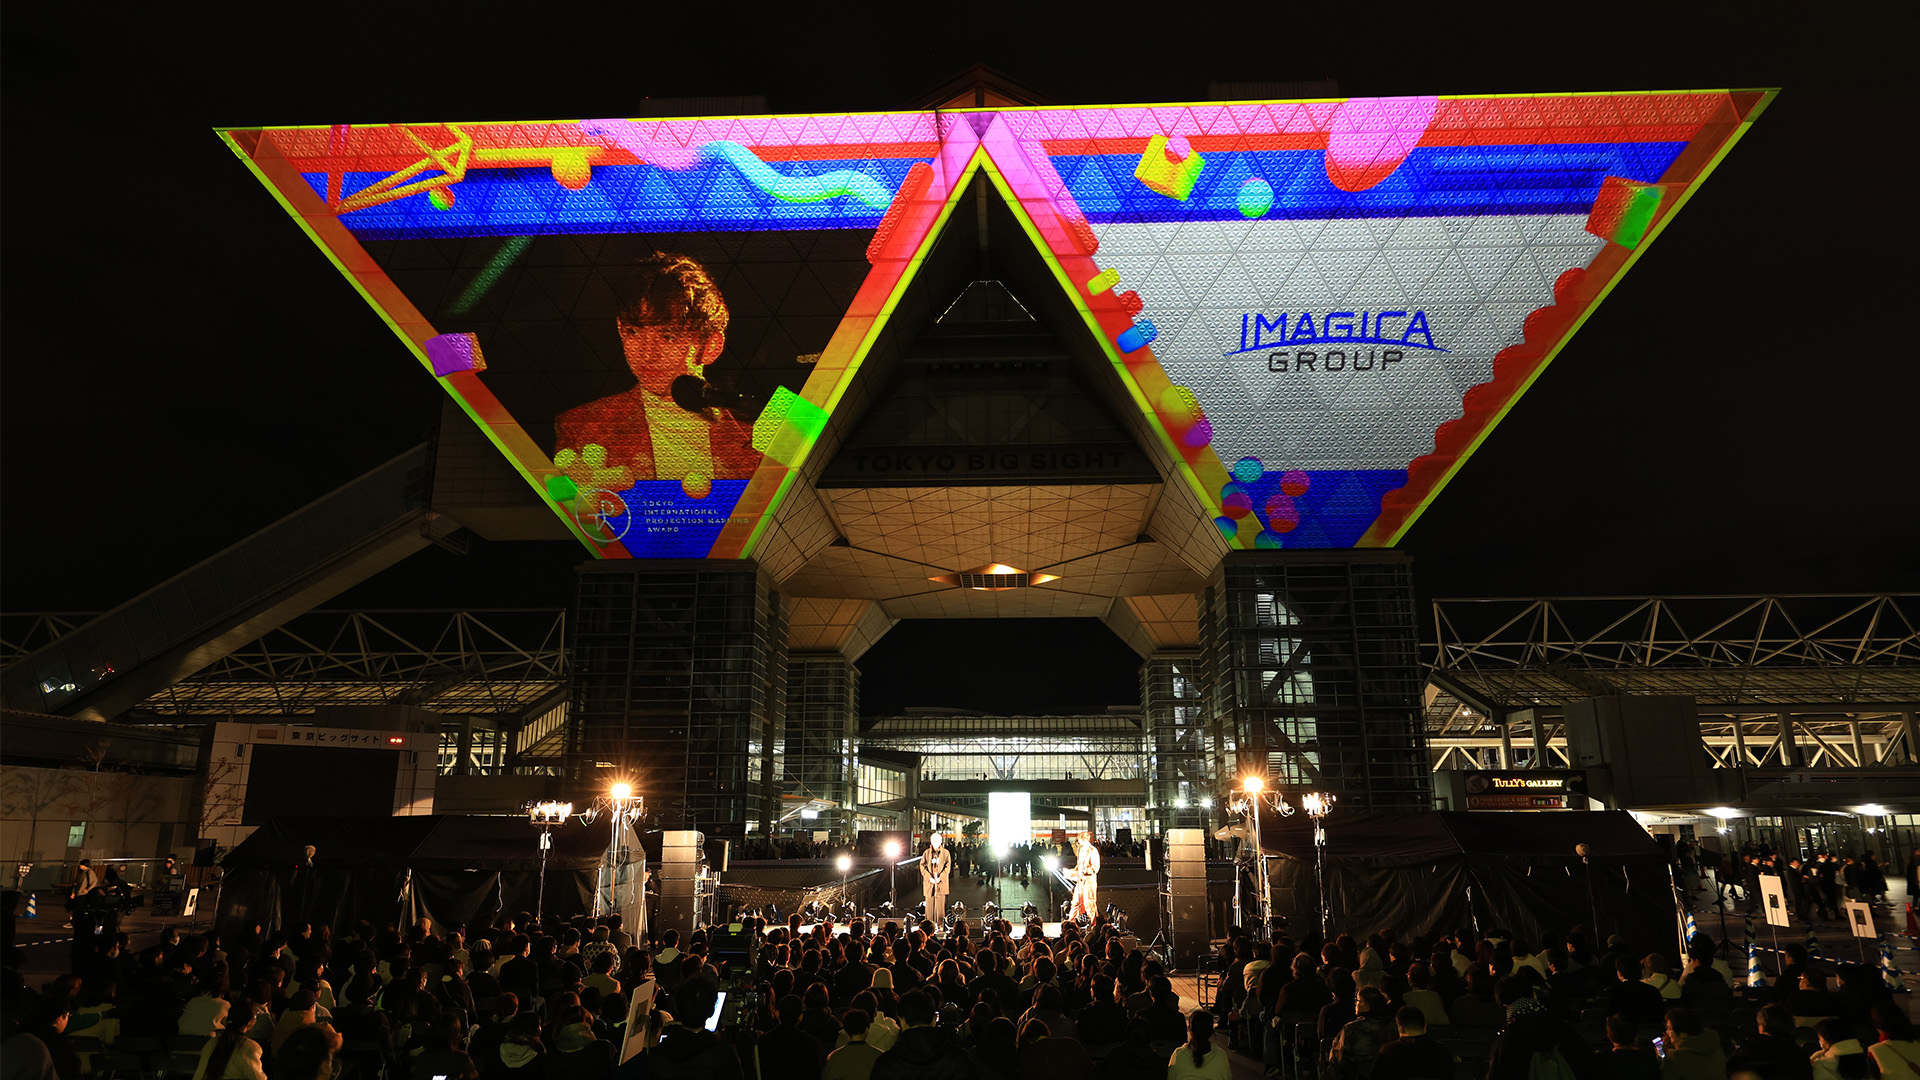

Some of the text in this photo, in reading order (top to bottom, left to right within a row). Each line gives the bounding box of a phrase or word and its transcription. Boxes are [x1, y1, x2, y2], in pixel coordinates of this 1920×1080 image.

[1240, 310, 1435, 350] IMAGICA
[1268, 351, 1403, 373] GROUP
[853, 451, 1126, 472] TOKYO BIG SIGHT
[291, 731, 380, 743] 東京ビッグサイト
[1526, 779, 1564, 788] GALLERY
